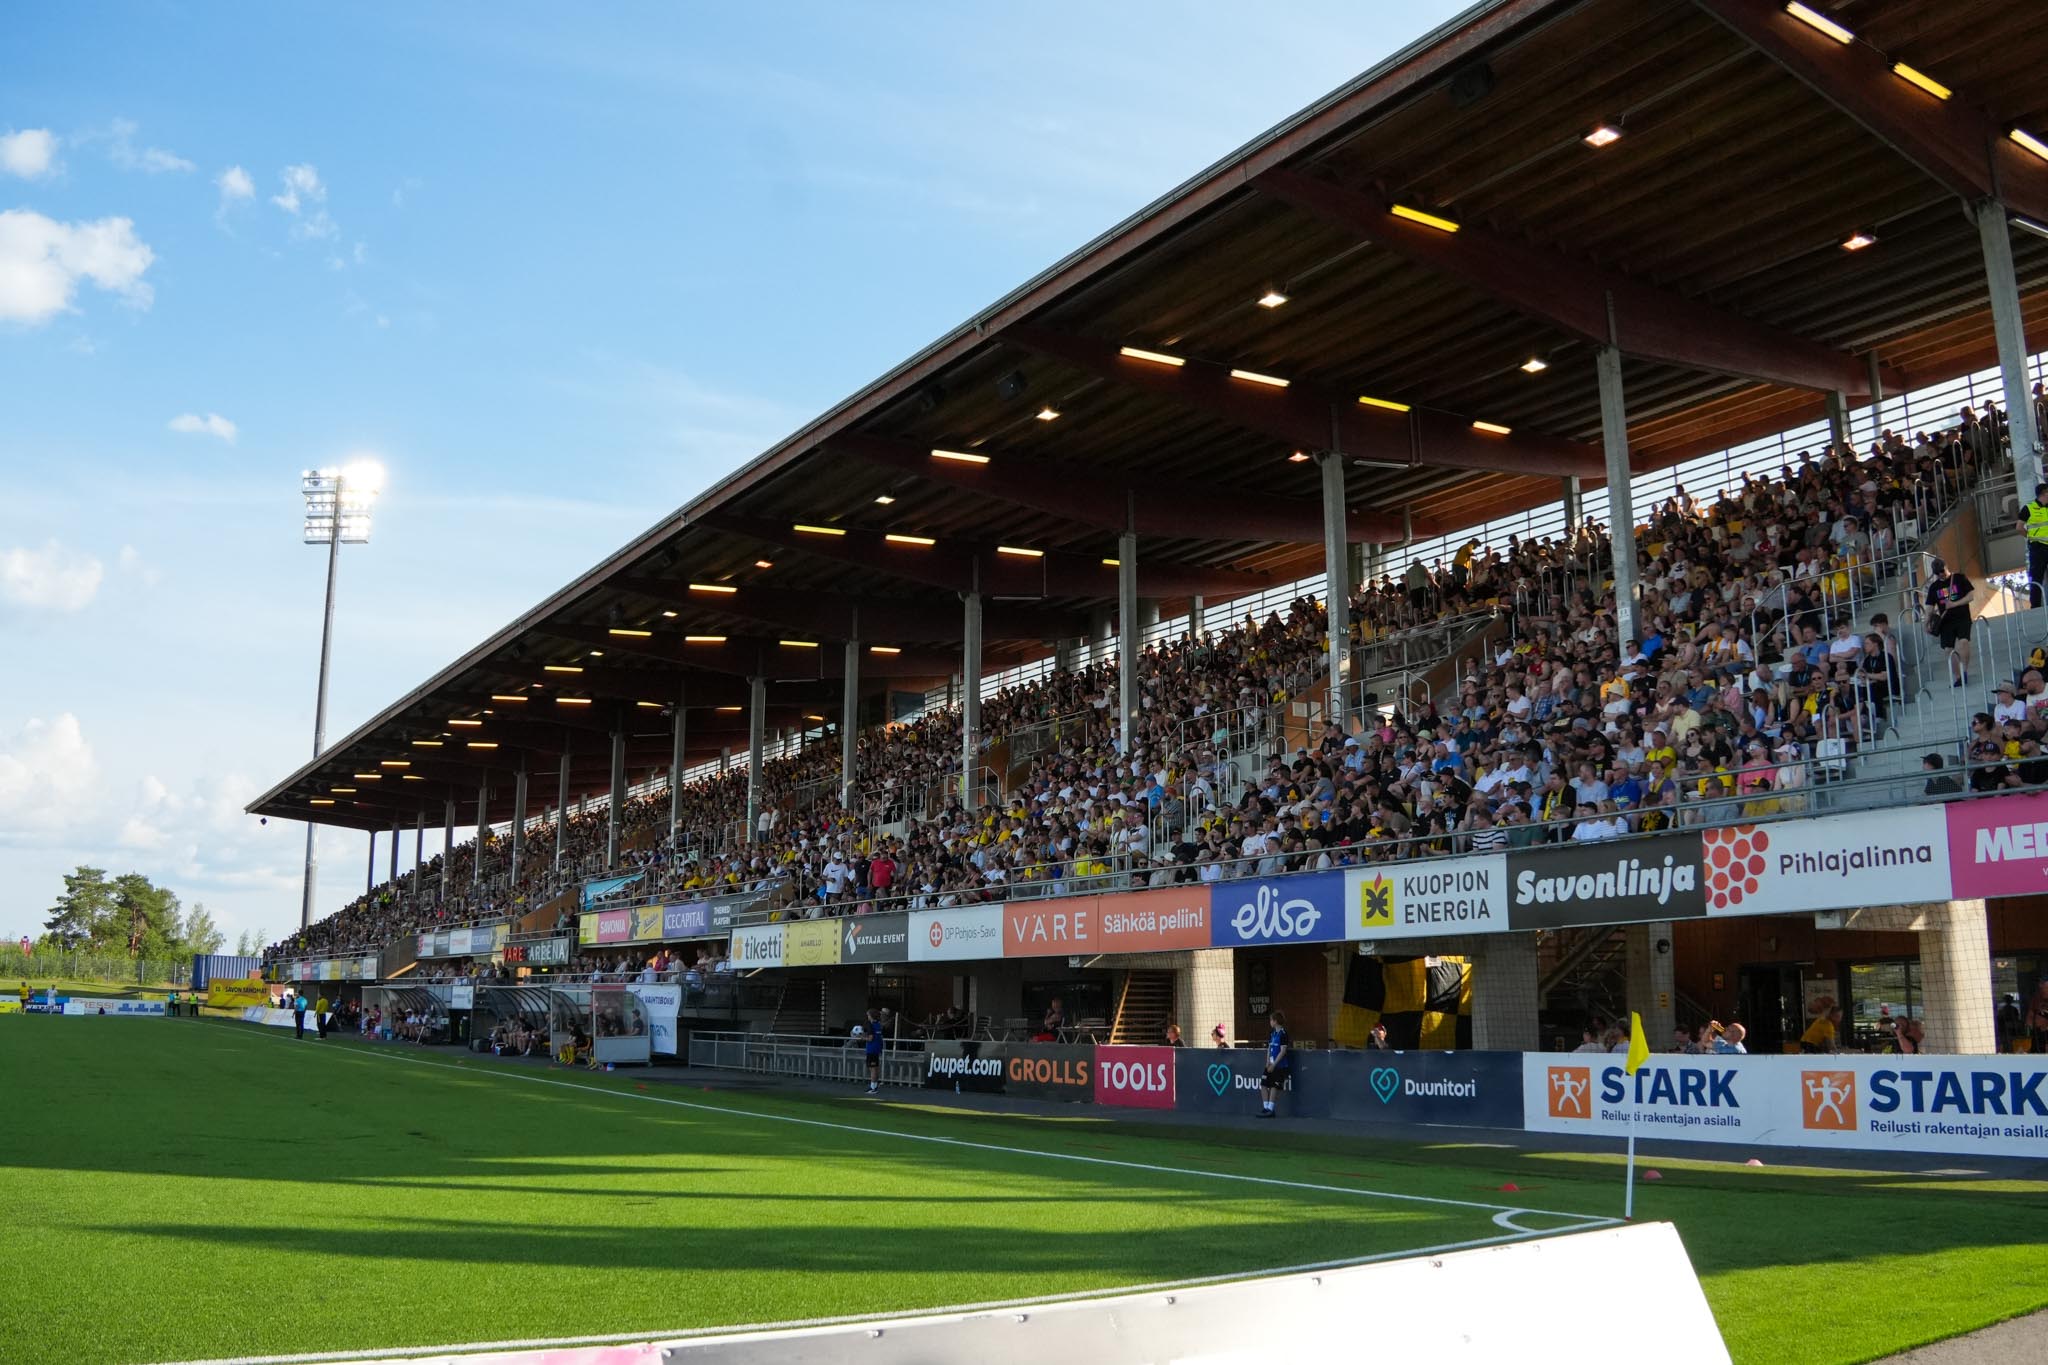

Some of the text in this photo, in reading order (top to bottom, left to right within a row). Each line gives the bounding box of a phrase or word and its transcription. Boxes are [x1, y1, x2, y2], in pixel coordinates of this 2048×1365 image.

[1779, 844, 1932, 877] Pihlajalinna
[1404, 870, 1489, 897] KUOPION
[1515, 855, 1696, 906] Savonlinja
[664, 911, 704, 930] ICECAPITAL
[1104, 907, 1204, 935] Sähköä peliin!
[1231, 885, 1321, 940] elisa
[1405, 898, 1490, 924] ENERGIA
[856, 933, 905, 945] KATAJA EVENT
[945, 925, 996, 941] OP Pohjois-Savo
[1013, 911, 1088, 944] VÄRE
[745, 932, 782, 960] tiketti
[1252, 1004, 1268, 1014] VIP
[927, 1052, 1002, 1079] joupet.com
[1009, 1057, 1089, 1086] GROLLS
[1101, 1061, 1167, 1092] TOOLS
[1404, 1079, 1476, 1098] Duunitori
[1600, 1066, 1740, 1108] STARK
[1868, 1069, 2048, 1116] STARK
[1643, 1111, 1701, 1127] rakentajan
[1703, 1115, 1741, 1127] asialla
[1870, 1119, 2048, 1139] Reilusti rakentajan asialla
